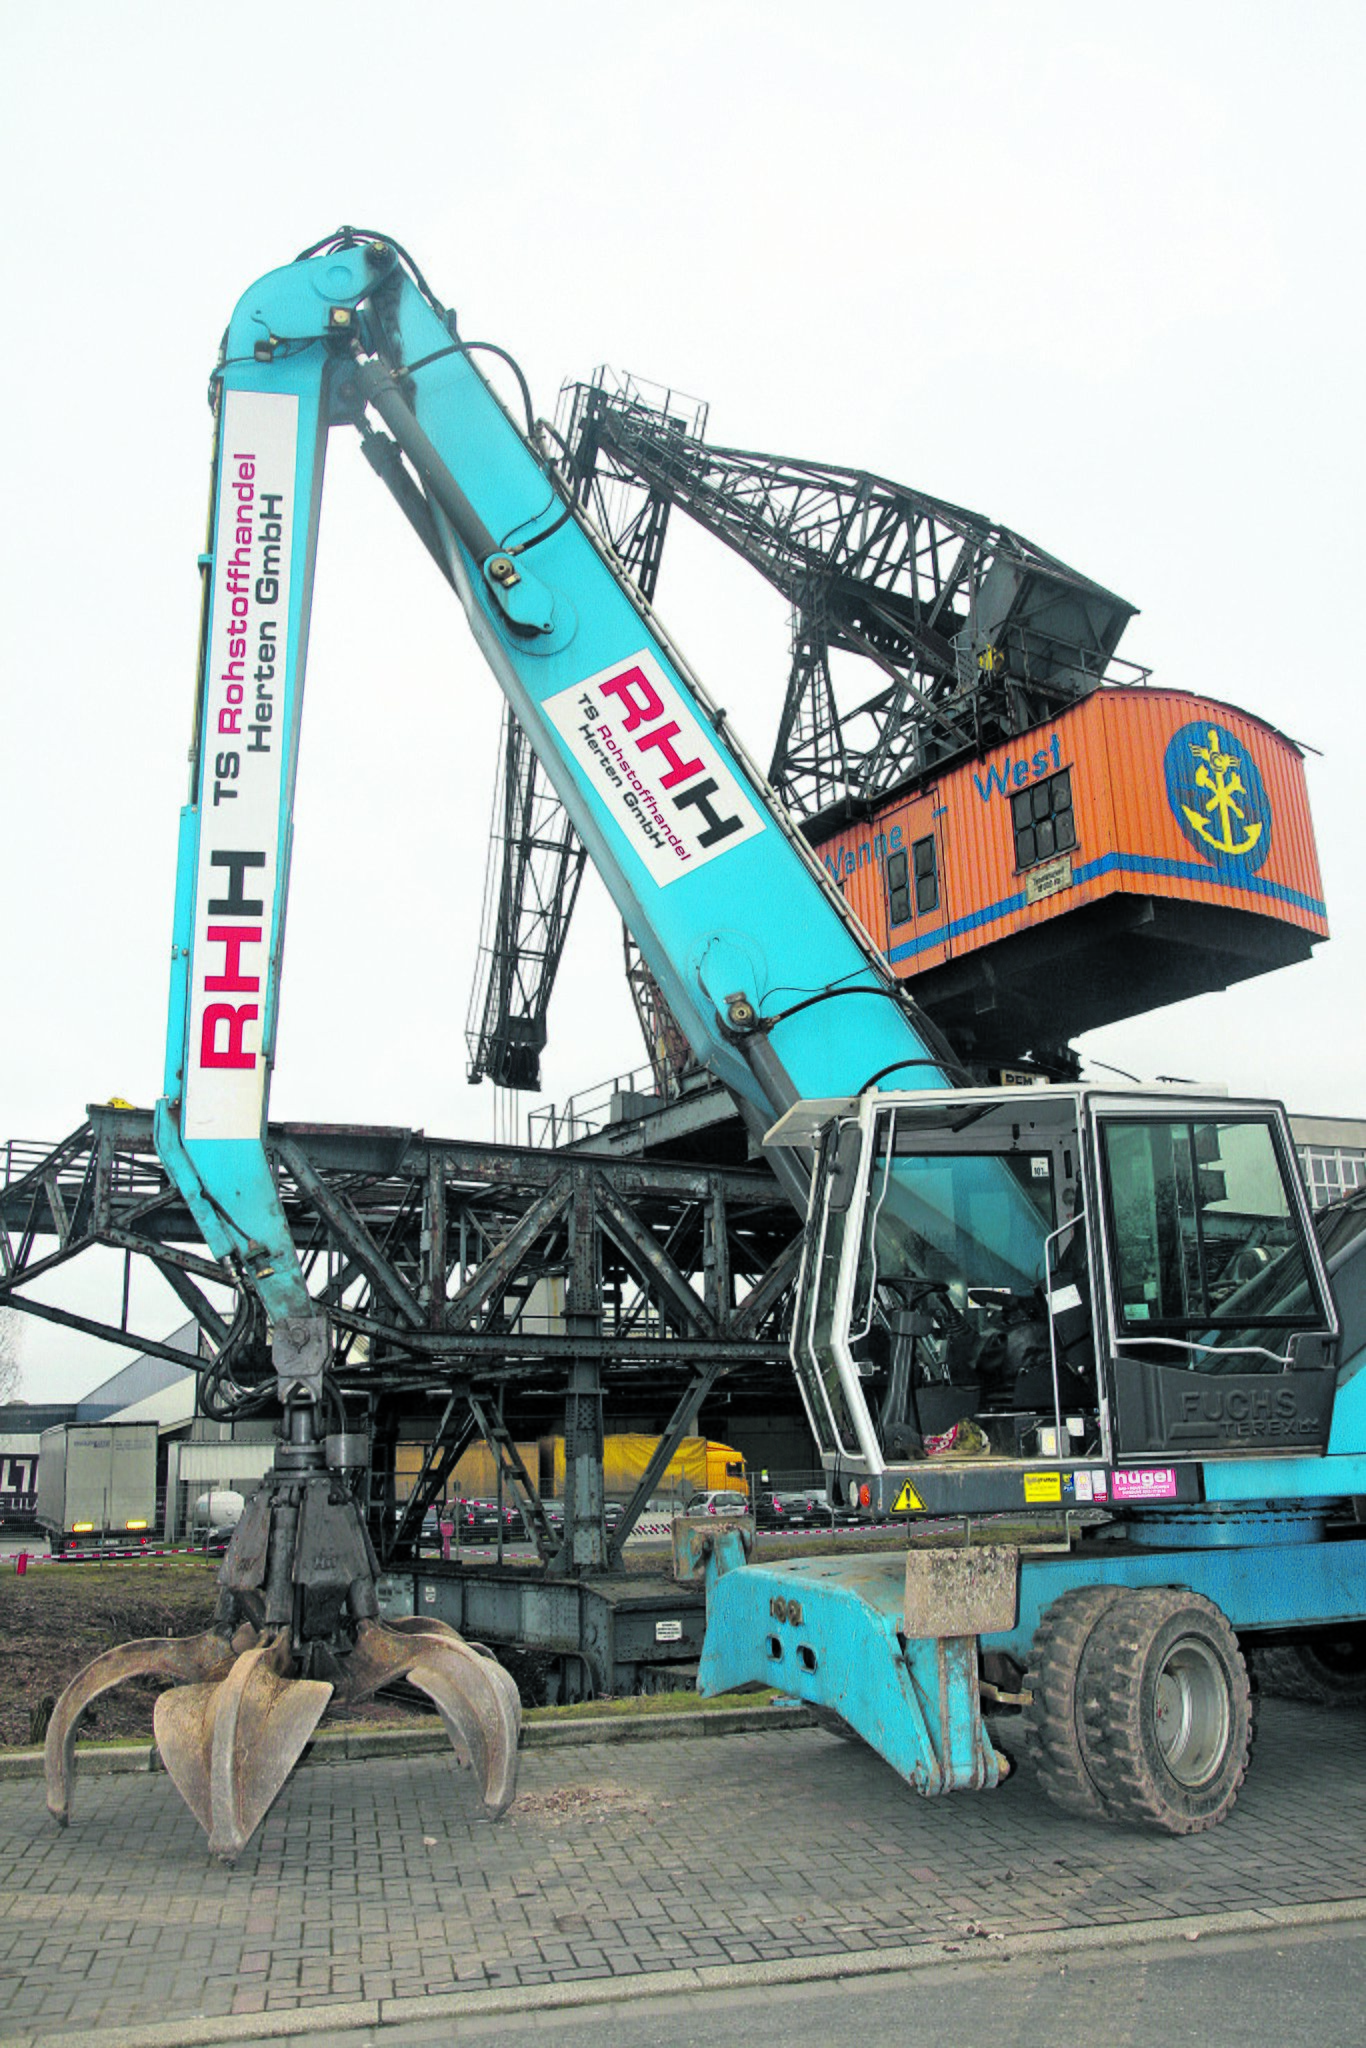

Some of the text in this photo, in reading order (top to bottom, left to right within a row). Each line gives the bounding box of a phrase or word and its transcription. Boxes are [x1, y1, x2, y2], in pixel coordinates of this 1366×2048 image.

[213, 453, 256, 806] TS Rohstoffhandel
[247, 494, 283, 753] Herten GmbH
[577, 693, 691, 861] TS Rohstoffhandel
[578, 724, 665, 849] Herten GmbH
[598, 665, 744, 849] RHH
[823, 824, 903, 882] Wanne
[973, 732, 1063, 803] West
[199, 850, 266, 1069] RHH
[1005, 1073, 1033, 1086] DEM
[1180, 1387, 1298, 1422] FUCHS
[1219, 1419, 1297, 1438] TEREX
[0, 1459, 39, 1493] LT
[1113, 1468, 1173, 1488] hügel
